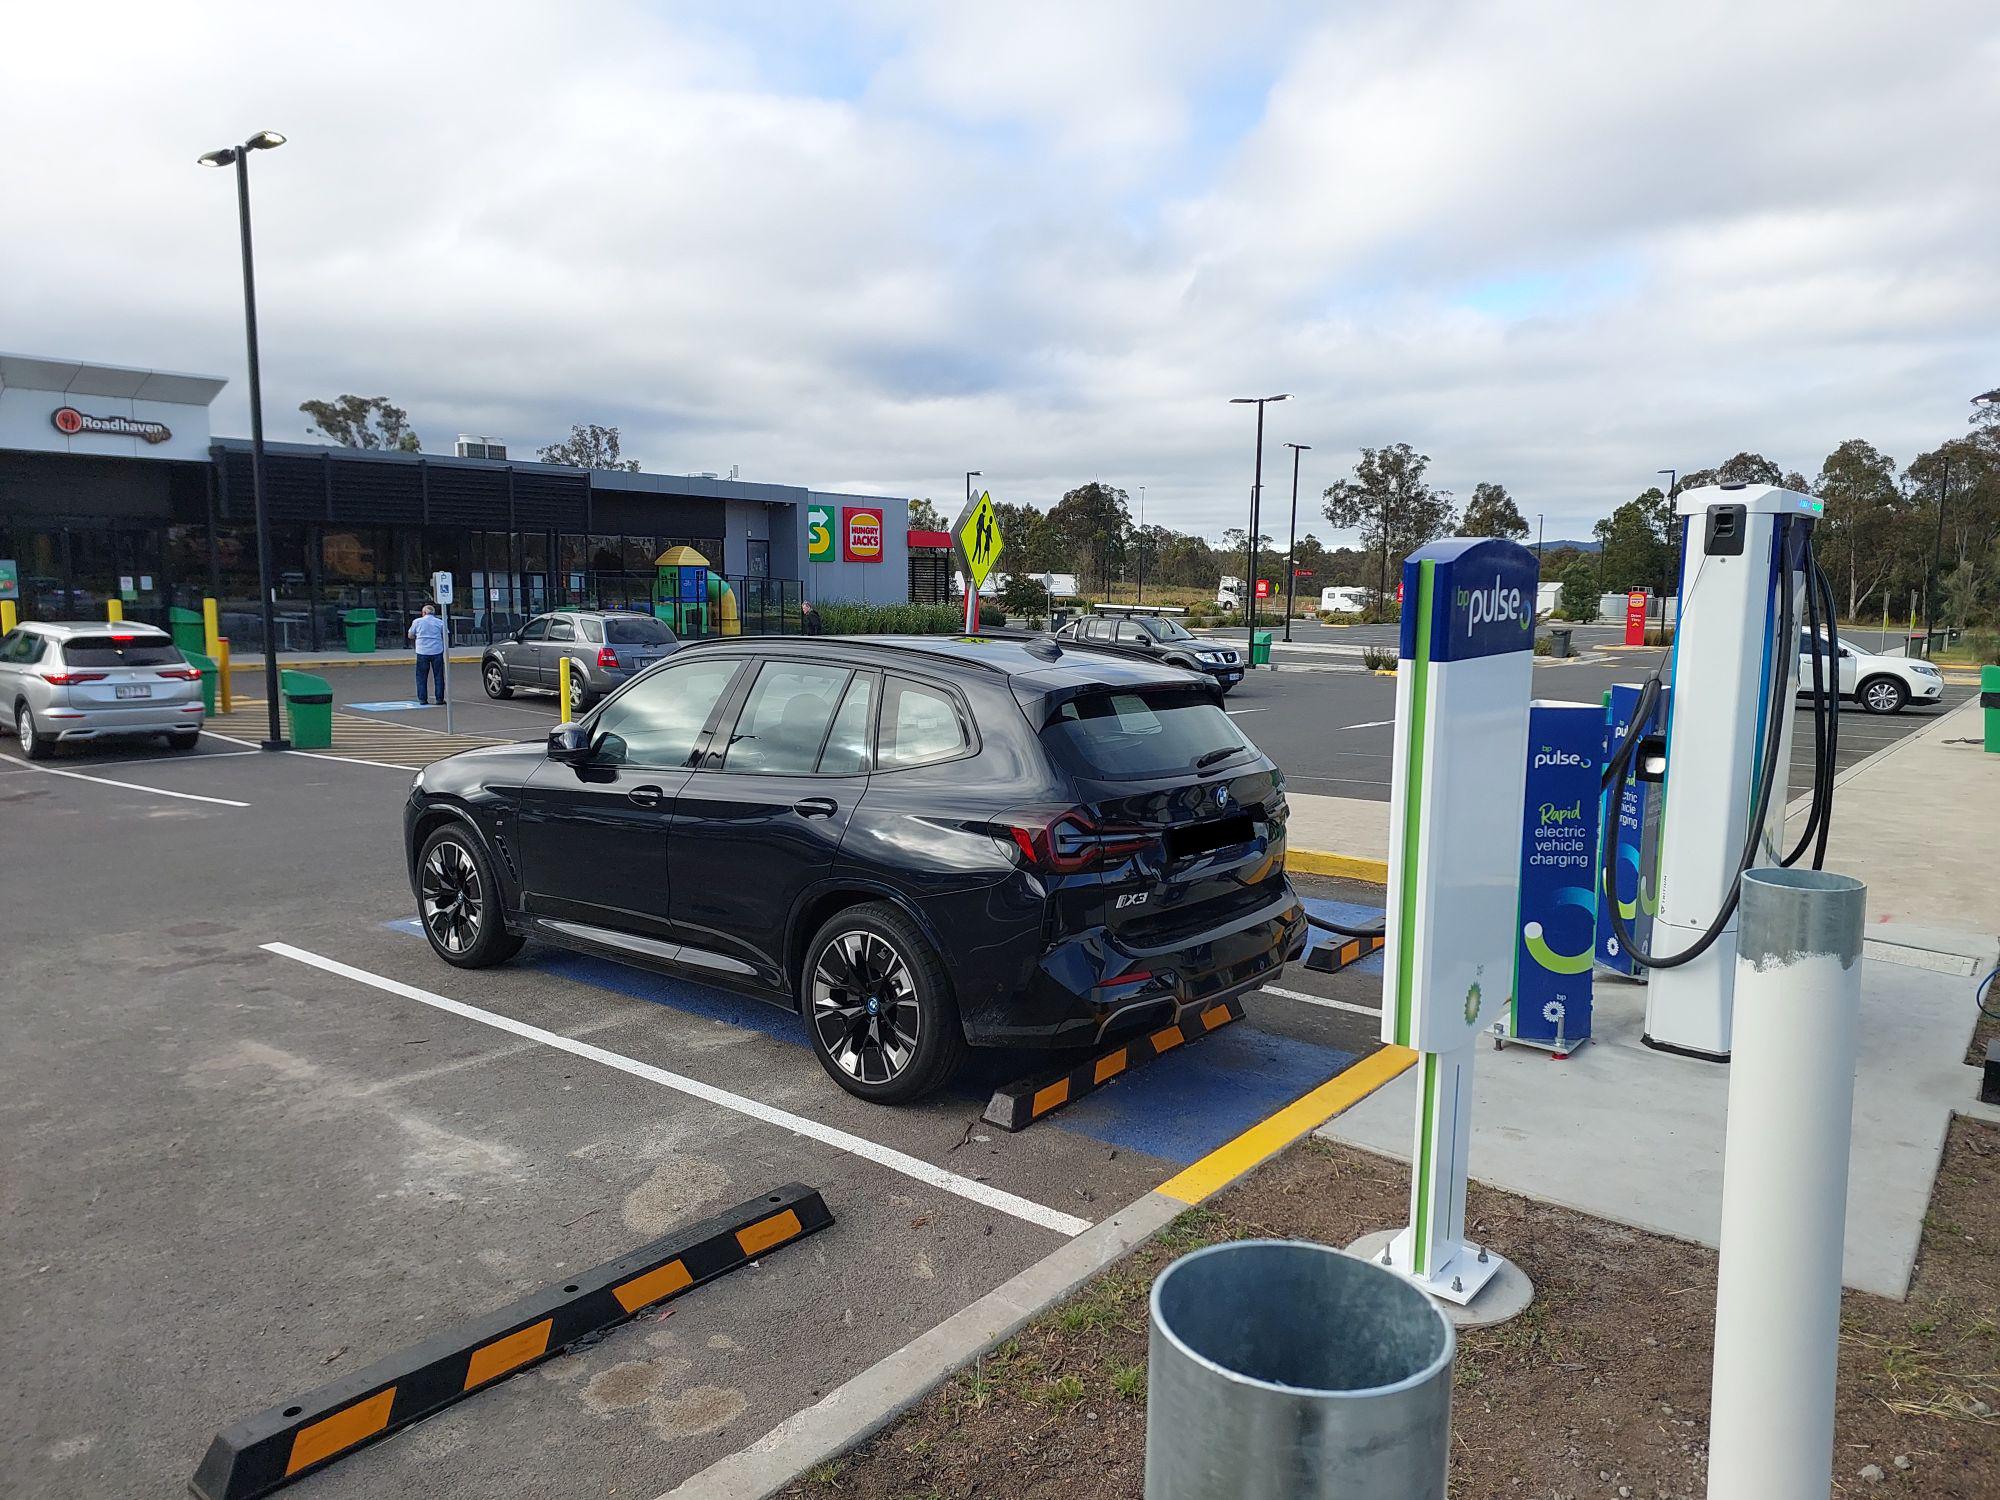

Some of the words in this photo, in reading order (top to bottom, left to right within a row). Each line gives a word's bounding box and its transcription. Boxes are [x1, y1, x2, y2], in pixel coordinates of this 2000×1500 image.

[82, 417, 163, 433] Roadhaven
[852, 526, 878, 535] HUNGRY
[852, 535, 878, 546] JACK'S
[1457, 585, 1470, 611] bp
[1468, 574, 1520, 637] pulse
[1534, 750, 1580, 768] pulse
[1538, 800, 1581, 825] Rapid
[1534, 825, 1586, 838] electric
[1535, 838, 1584, 851] vehicle
[1529, 853, 1589, 868] charging
[1556, 993, 1567, 1001] bp
